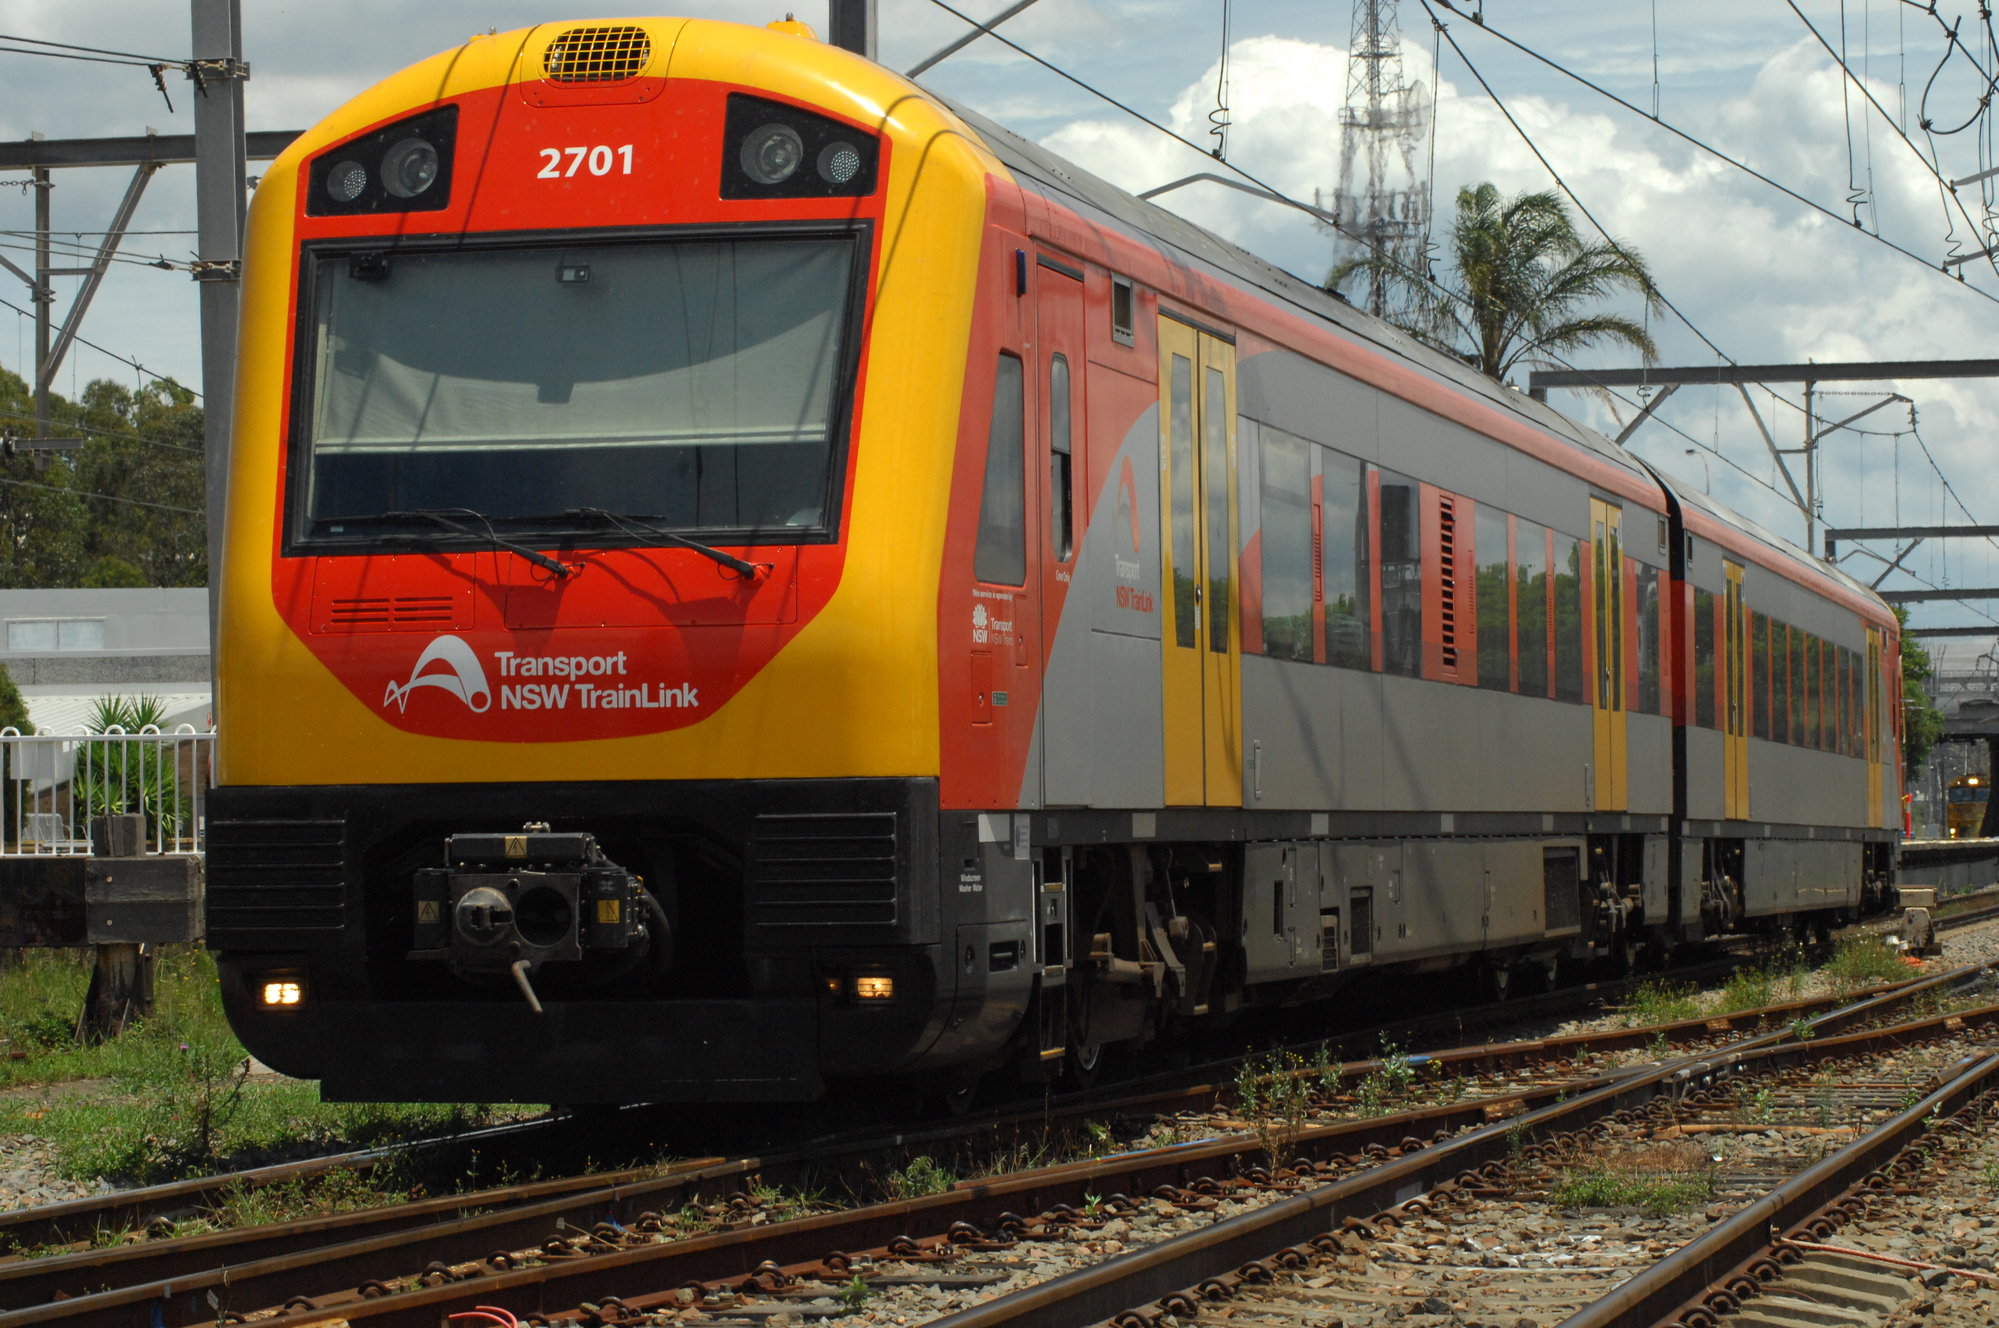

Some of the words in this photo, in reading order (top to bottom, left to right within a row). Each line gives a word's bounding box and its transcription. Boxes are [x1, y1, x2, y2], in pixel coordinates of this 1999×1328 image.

[537, 144, 633, 179] 2701
[1114, 553, 1140, 583] Transport
[1116, 584, 1129, 609] NSW
[1129, 587, 1154, 613] TrainLink
[973, 629, 988, 643] NSW
[991, 617, 1012, 633] Transport
[495, 651, 627, 681] Transport
[501, 684, 569, 710] NSW
[575, 683, 699, 708] TrainLink
